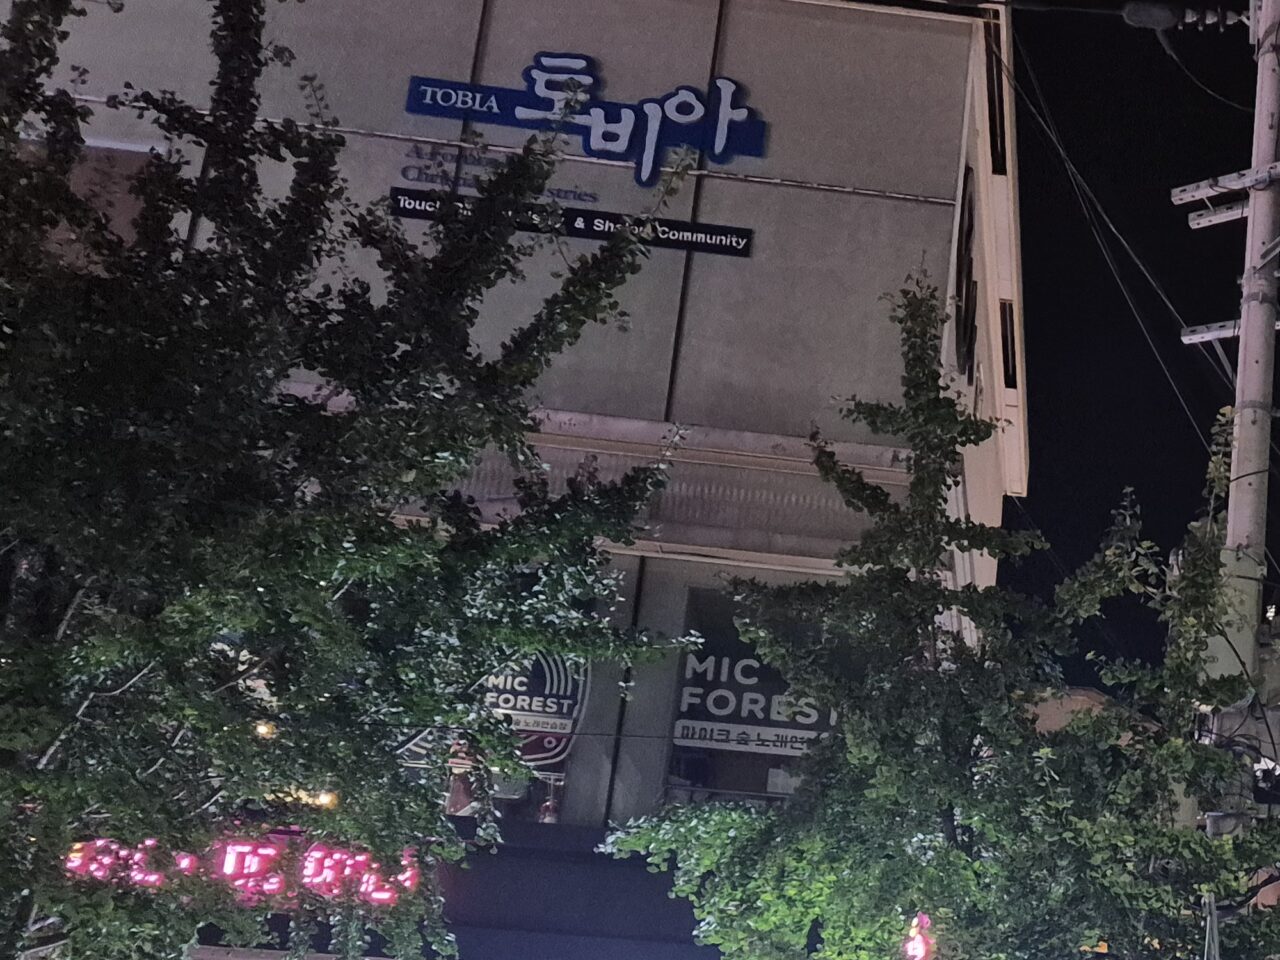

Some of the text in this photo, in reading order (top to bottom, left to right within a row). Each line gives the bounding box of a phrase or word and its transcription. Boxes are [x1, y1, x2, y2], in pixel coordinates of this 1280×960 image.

[420, 86, 501, 114] TOBIA
[514, 55, 749, 182] 토비아
[574, 217, 586, 230] &
[658, 226, 748, 250] Community
[487, 674, 528, 691] MIC
[683, 653, 761, 685] MIC
[485, 691, 573, 714] FOREST
